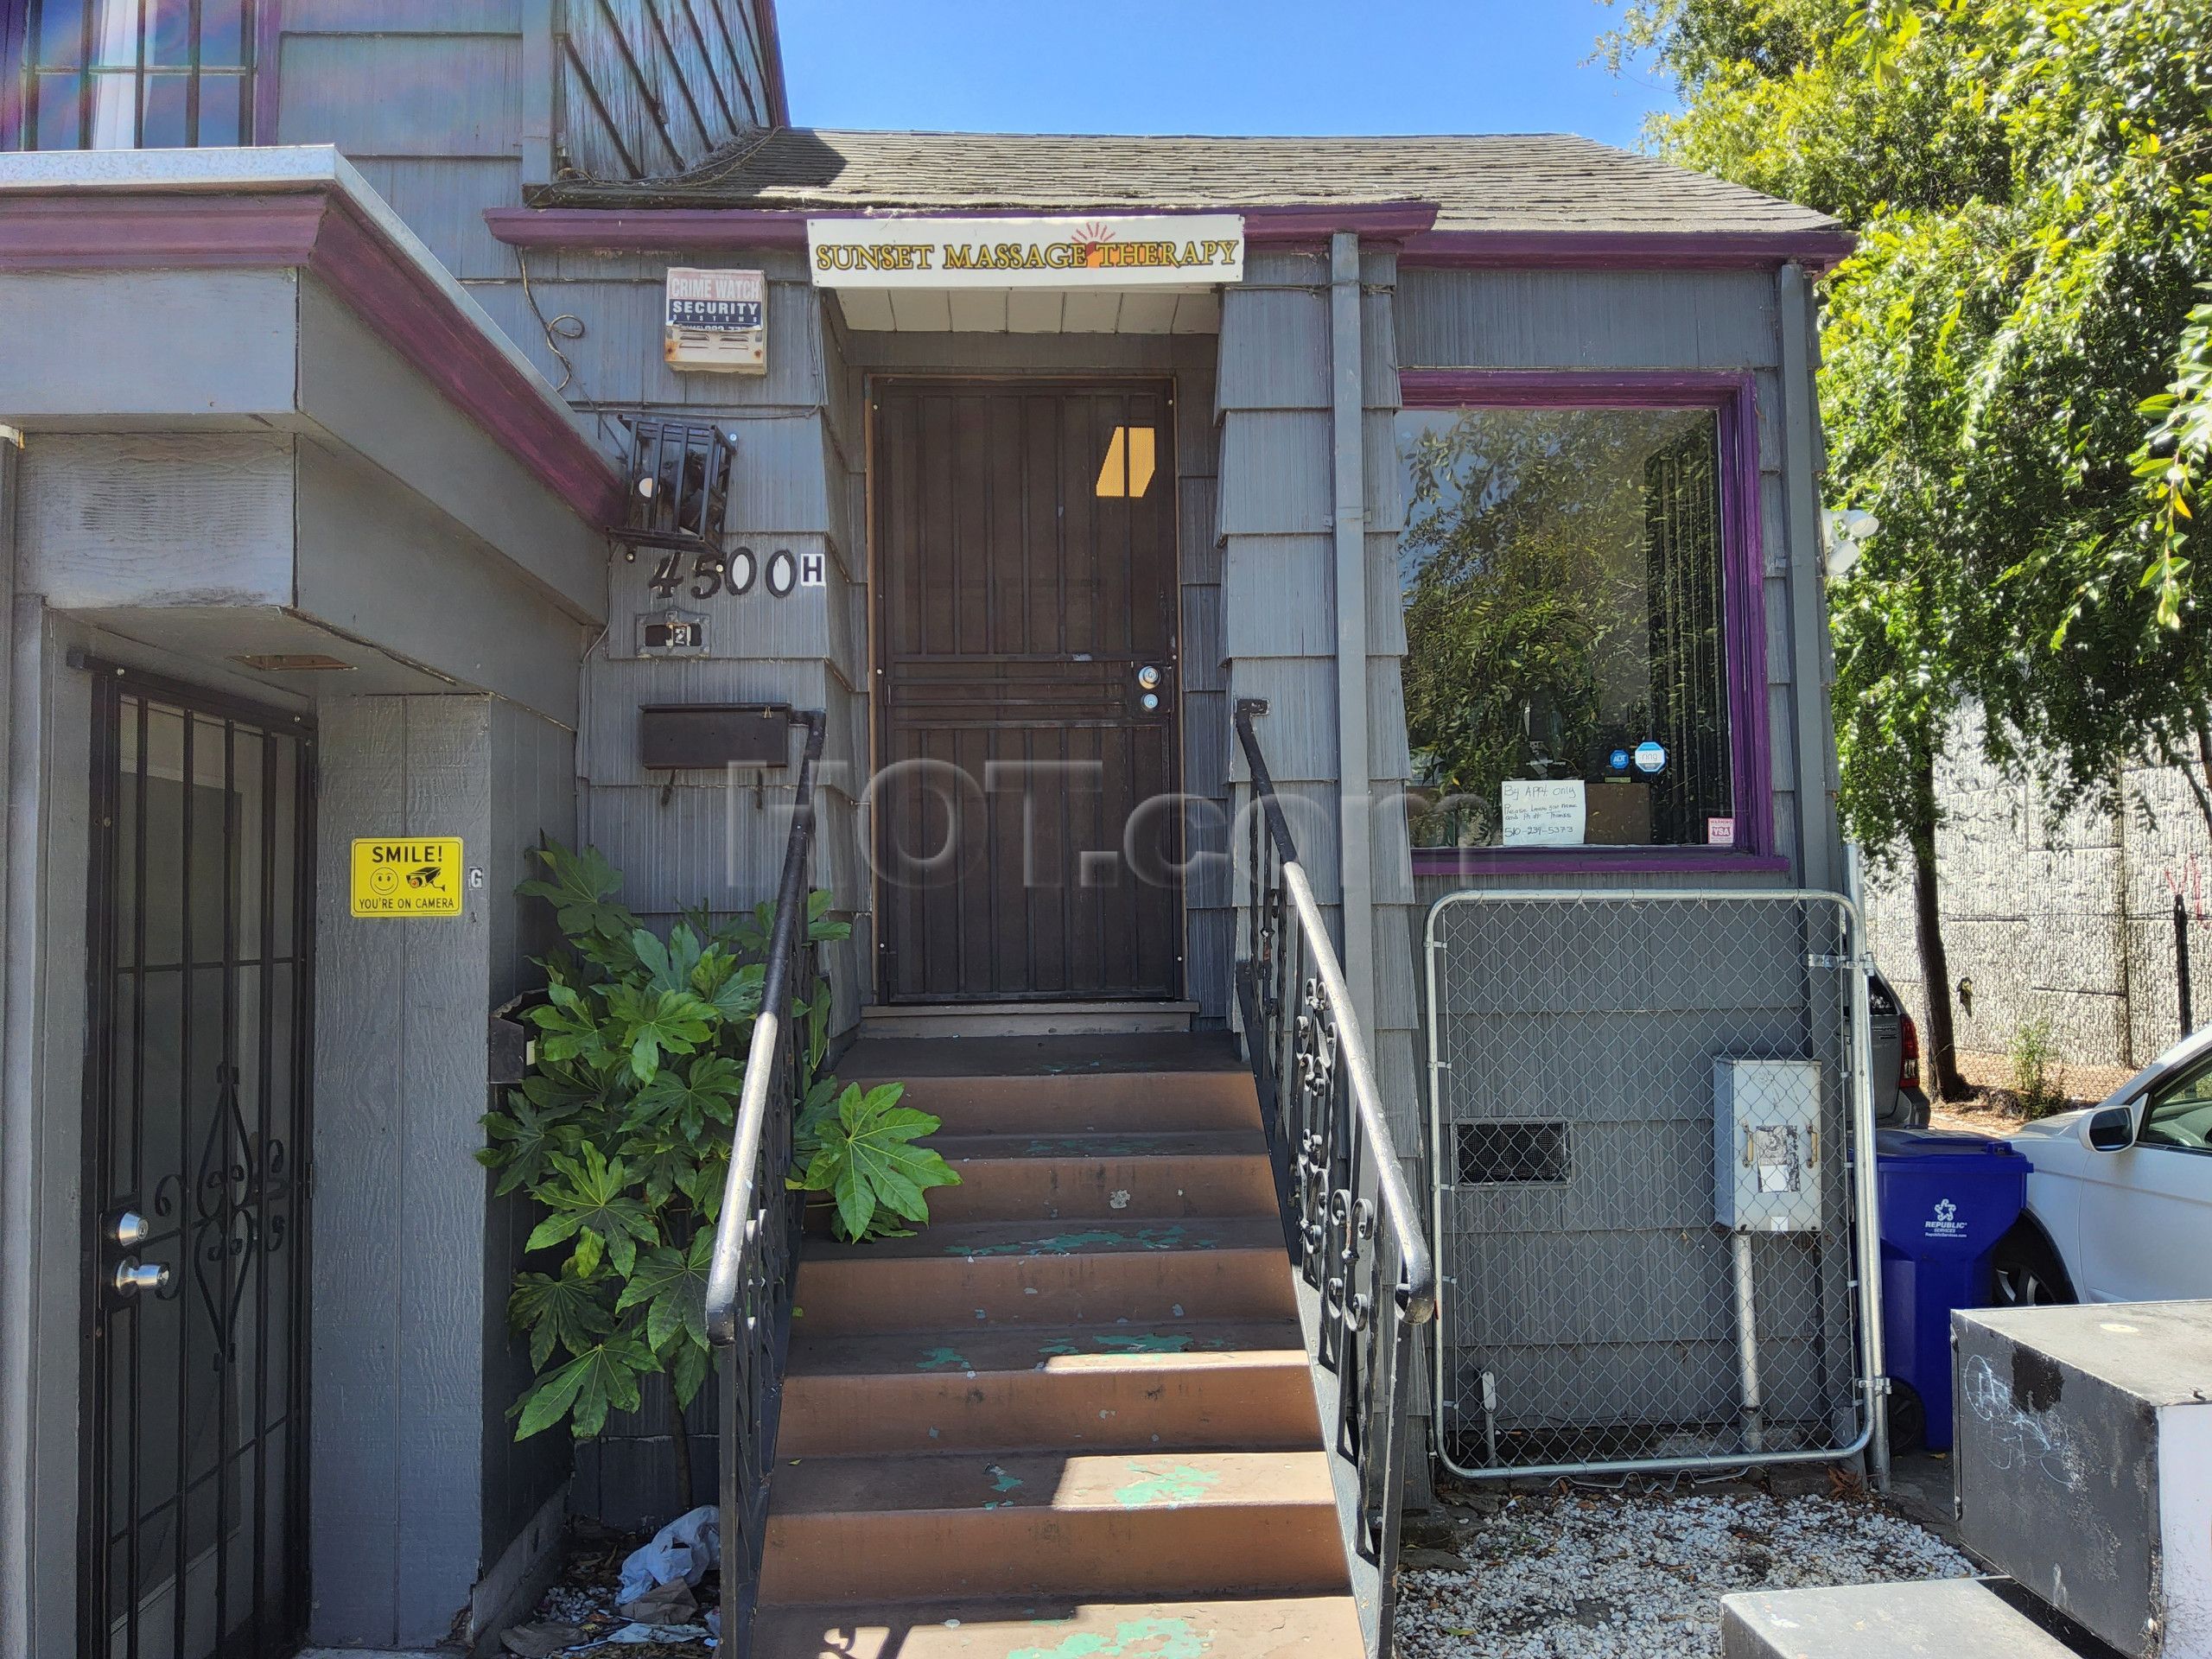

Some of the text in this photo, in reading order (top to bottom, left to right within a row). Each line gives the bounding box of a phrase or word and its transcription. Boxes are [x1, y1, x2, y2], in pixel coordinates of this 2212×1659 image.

[817, 239, 1239, 270] SUNSET MASSAGE THERAPY
[671, 277, 760, 299] CRIME WATCH
[673, 301, 758, 315] SECURITY
[648, 546, 823, 599] 4500 H
[1642, 753, 1657, 761] ring
[1504, 785, 1519, 800] By
[372, 846, 442, 862] SMILE!
[471, 869, 482, 887] G
[359, 898, 454, 908] YOU'RE ON CAMERA
